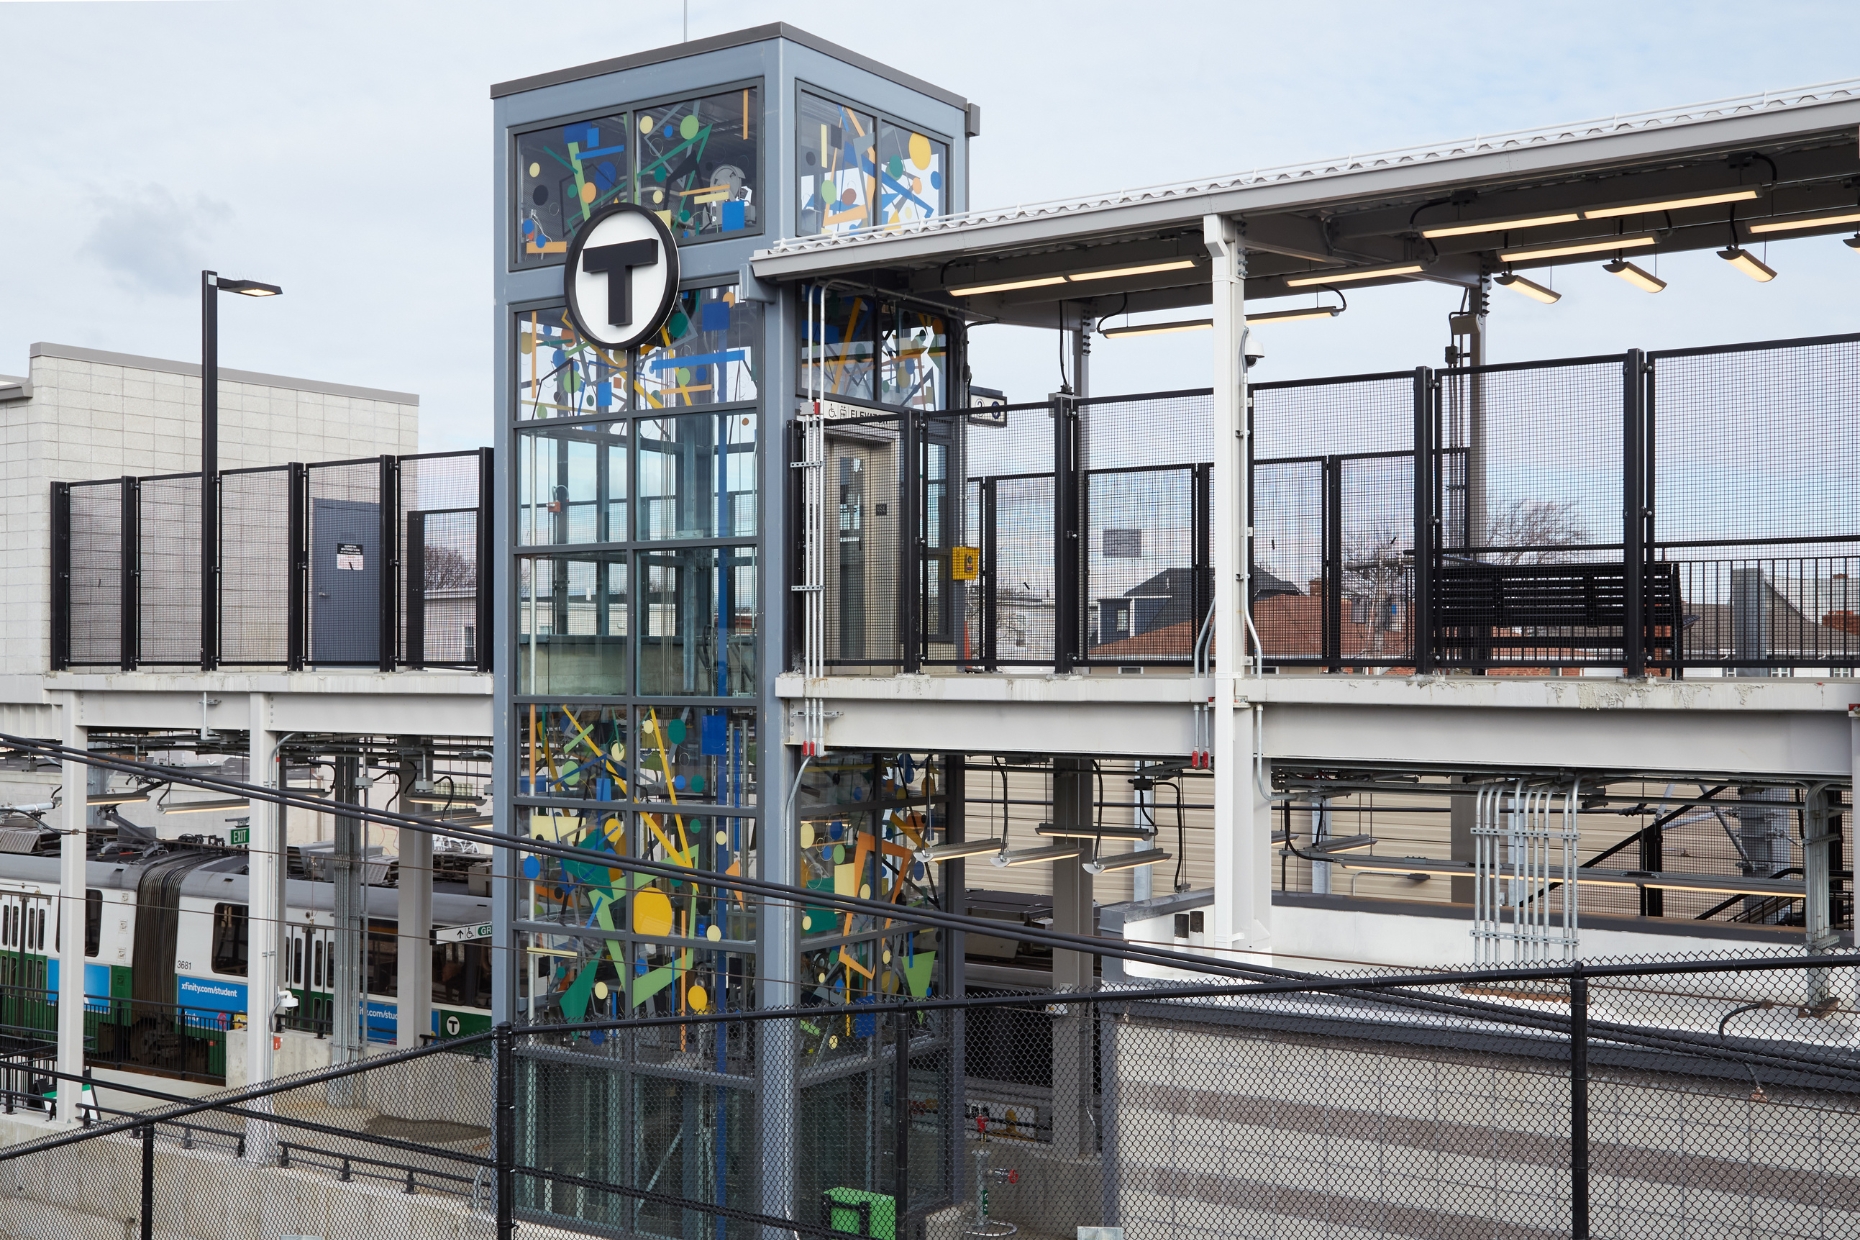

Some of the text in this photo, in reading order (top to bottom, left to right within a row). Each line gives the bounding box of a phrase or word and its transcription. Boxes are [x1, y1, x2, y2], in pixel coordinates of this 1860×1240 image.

[582, 238, 659, 327] T
[234, 830, 246, 843] EXIT
[177, 960, 192, 970] 3681
[181, 982, 238, 997] xfinity.com/student
[449, 1020, 458, 1033] T
